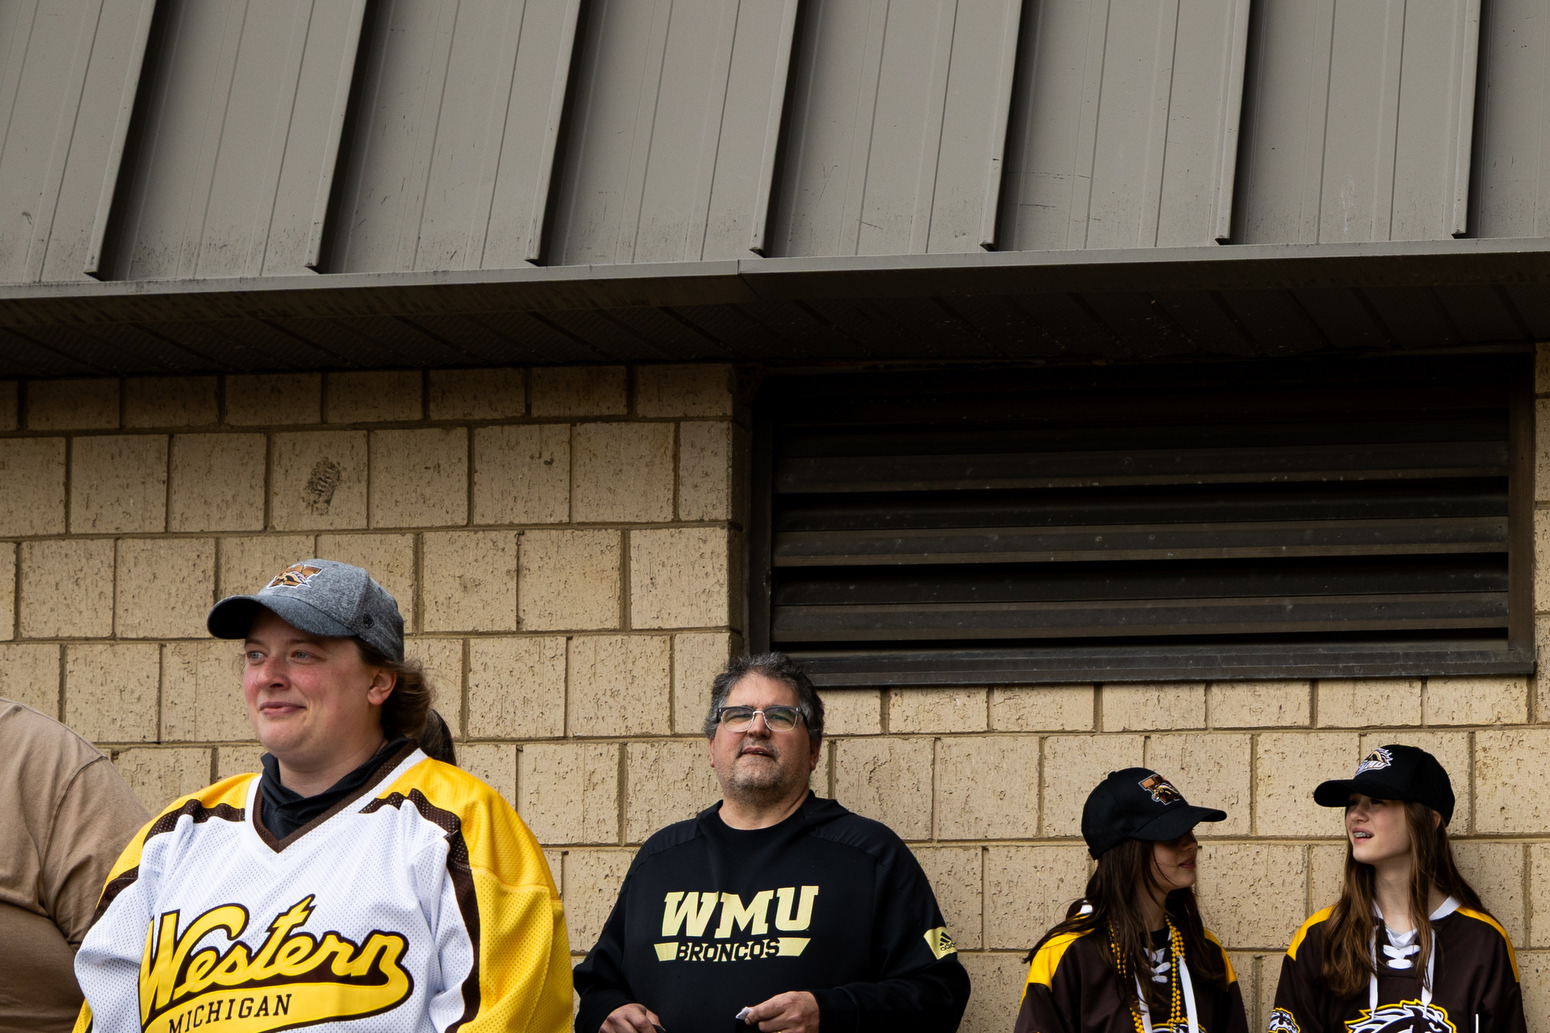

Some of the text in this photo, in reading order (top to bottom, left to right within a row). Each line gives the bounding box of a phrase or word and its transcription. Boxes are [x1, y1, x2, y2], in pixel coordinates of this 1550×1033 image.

[661, 885, 819, 939] WMU
[139, 894, 410, 1028] Western
[677, 939, 781, 962] BRONCOS
